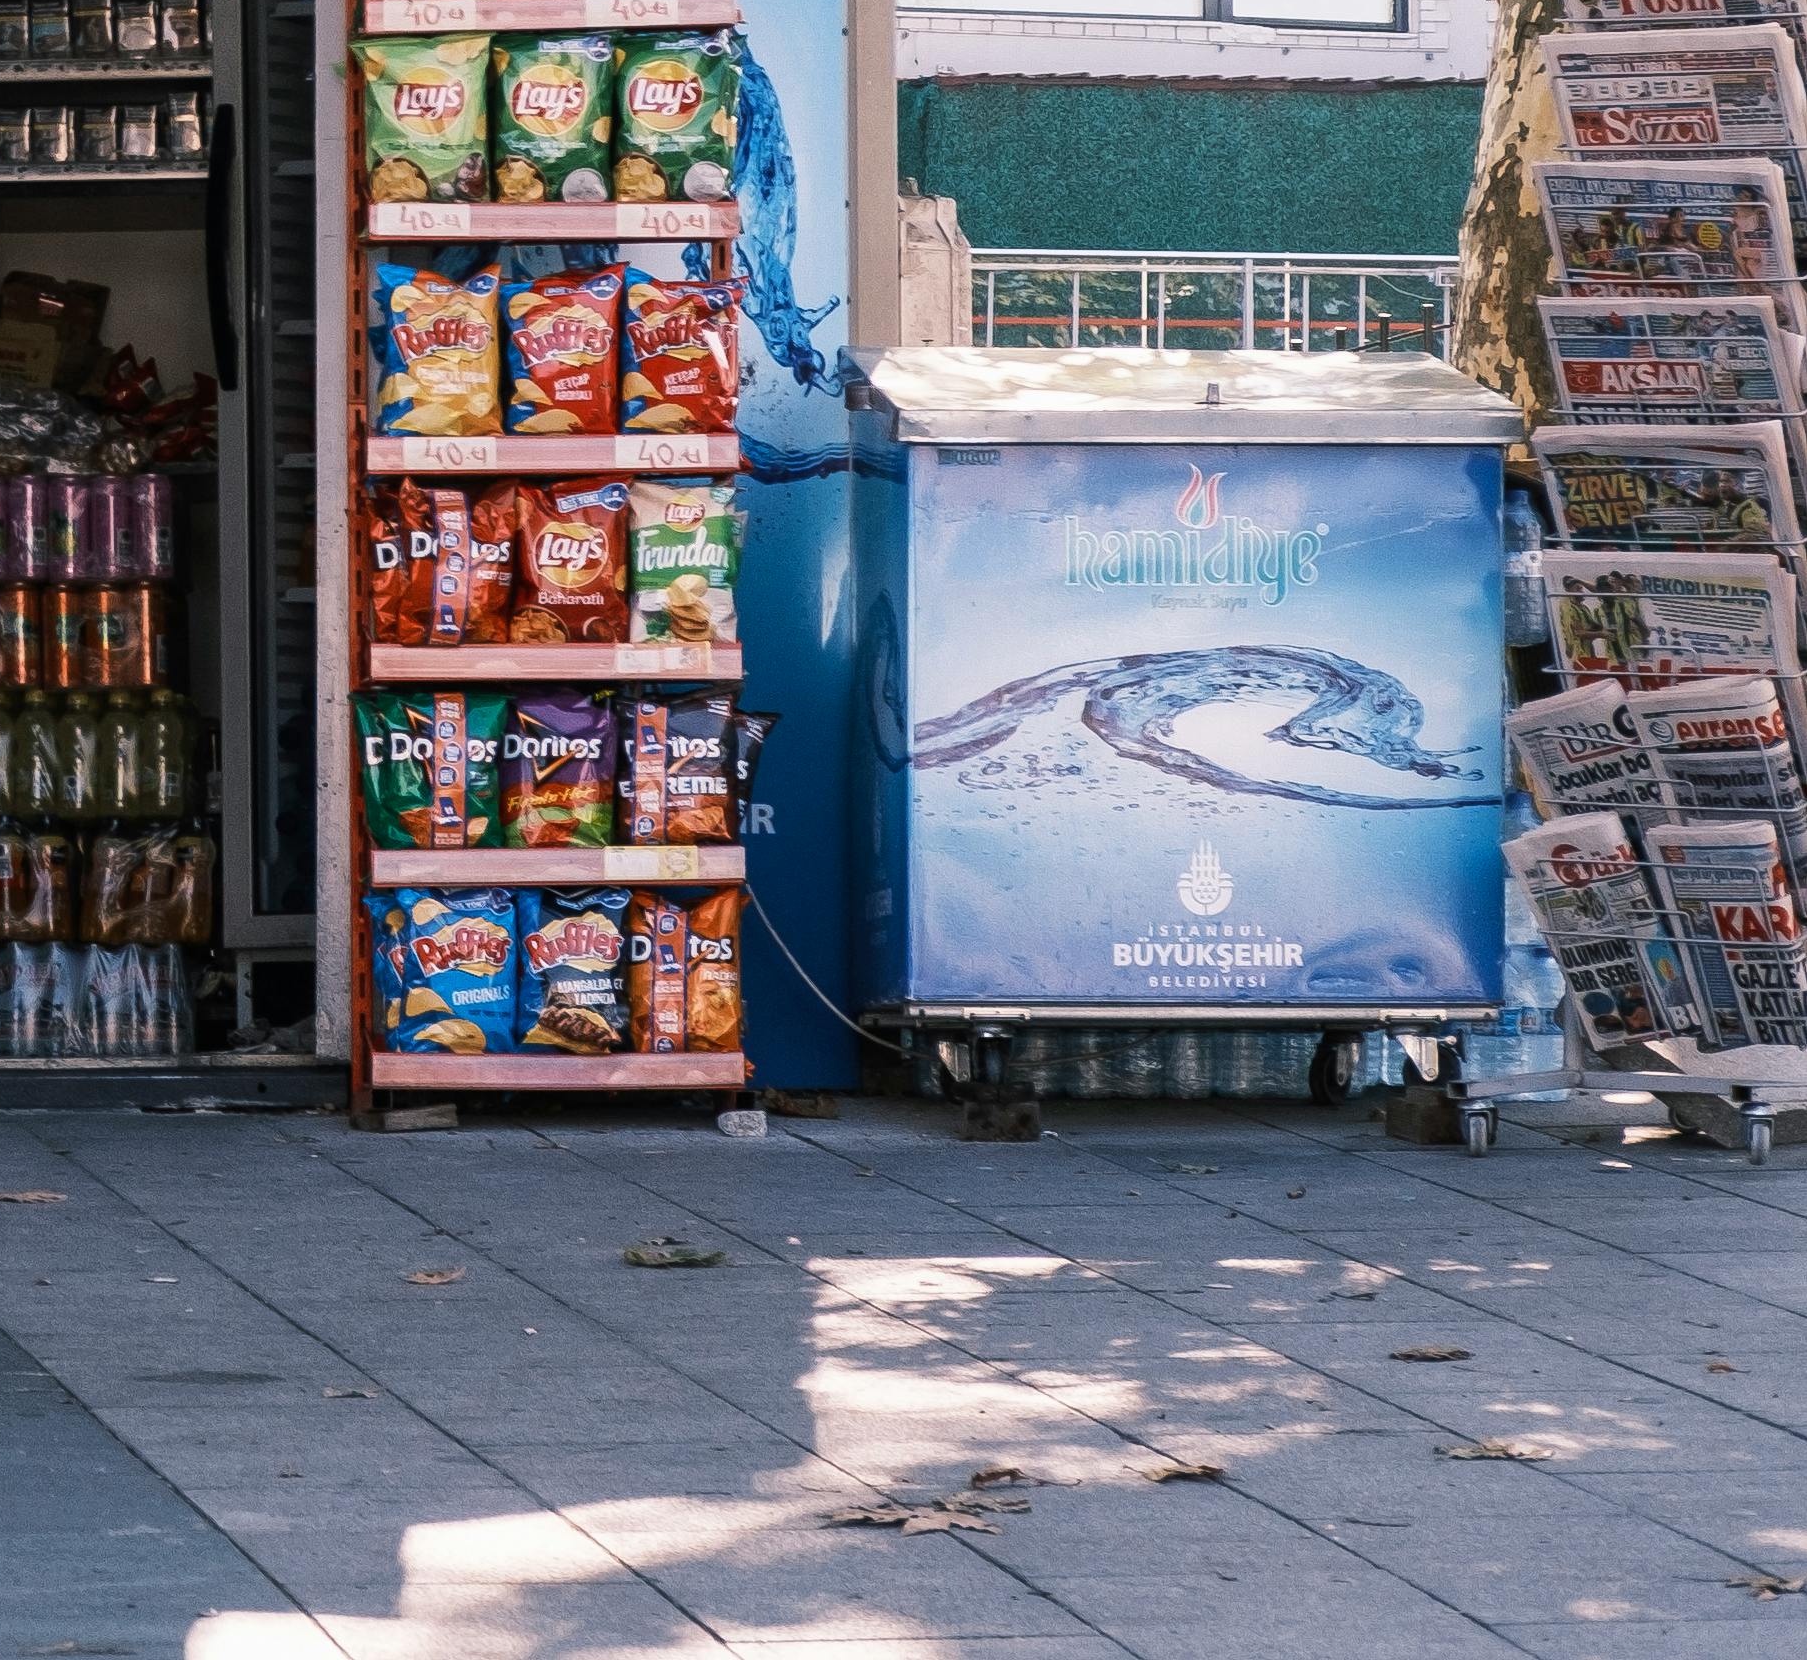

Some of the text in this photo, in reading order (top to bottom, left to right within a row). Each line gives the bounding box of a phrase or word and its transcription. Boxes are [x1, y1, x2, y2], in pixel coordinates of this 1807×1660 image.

[393, 317, 492, 366] Ruffles
[512, 317, 615, 368] Ruffles
[538, 533, 604, 571] Lay's
[1064, 516, 1321, 606] hamidiye
[504, 733, 603, 761] Doritos
[411, 923, 511, 978] Ruffles
[523, 921, 624, 973] Ruffles
[1113, 937, 1304, 975] BÜYÜKŞEHİR
